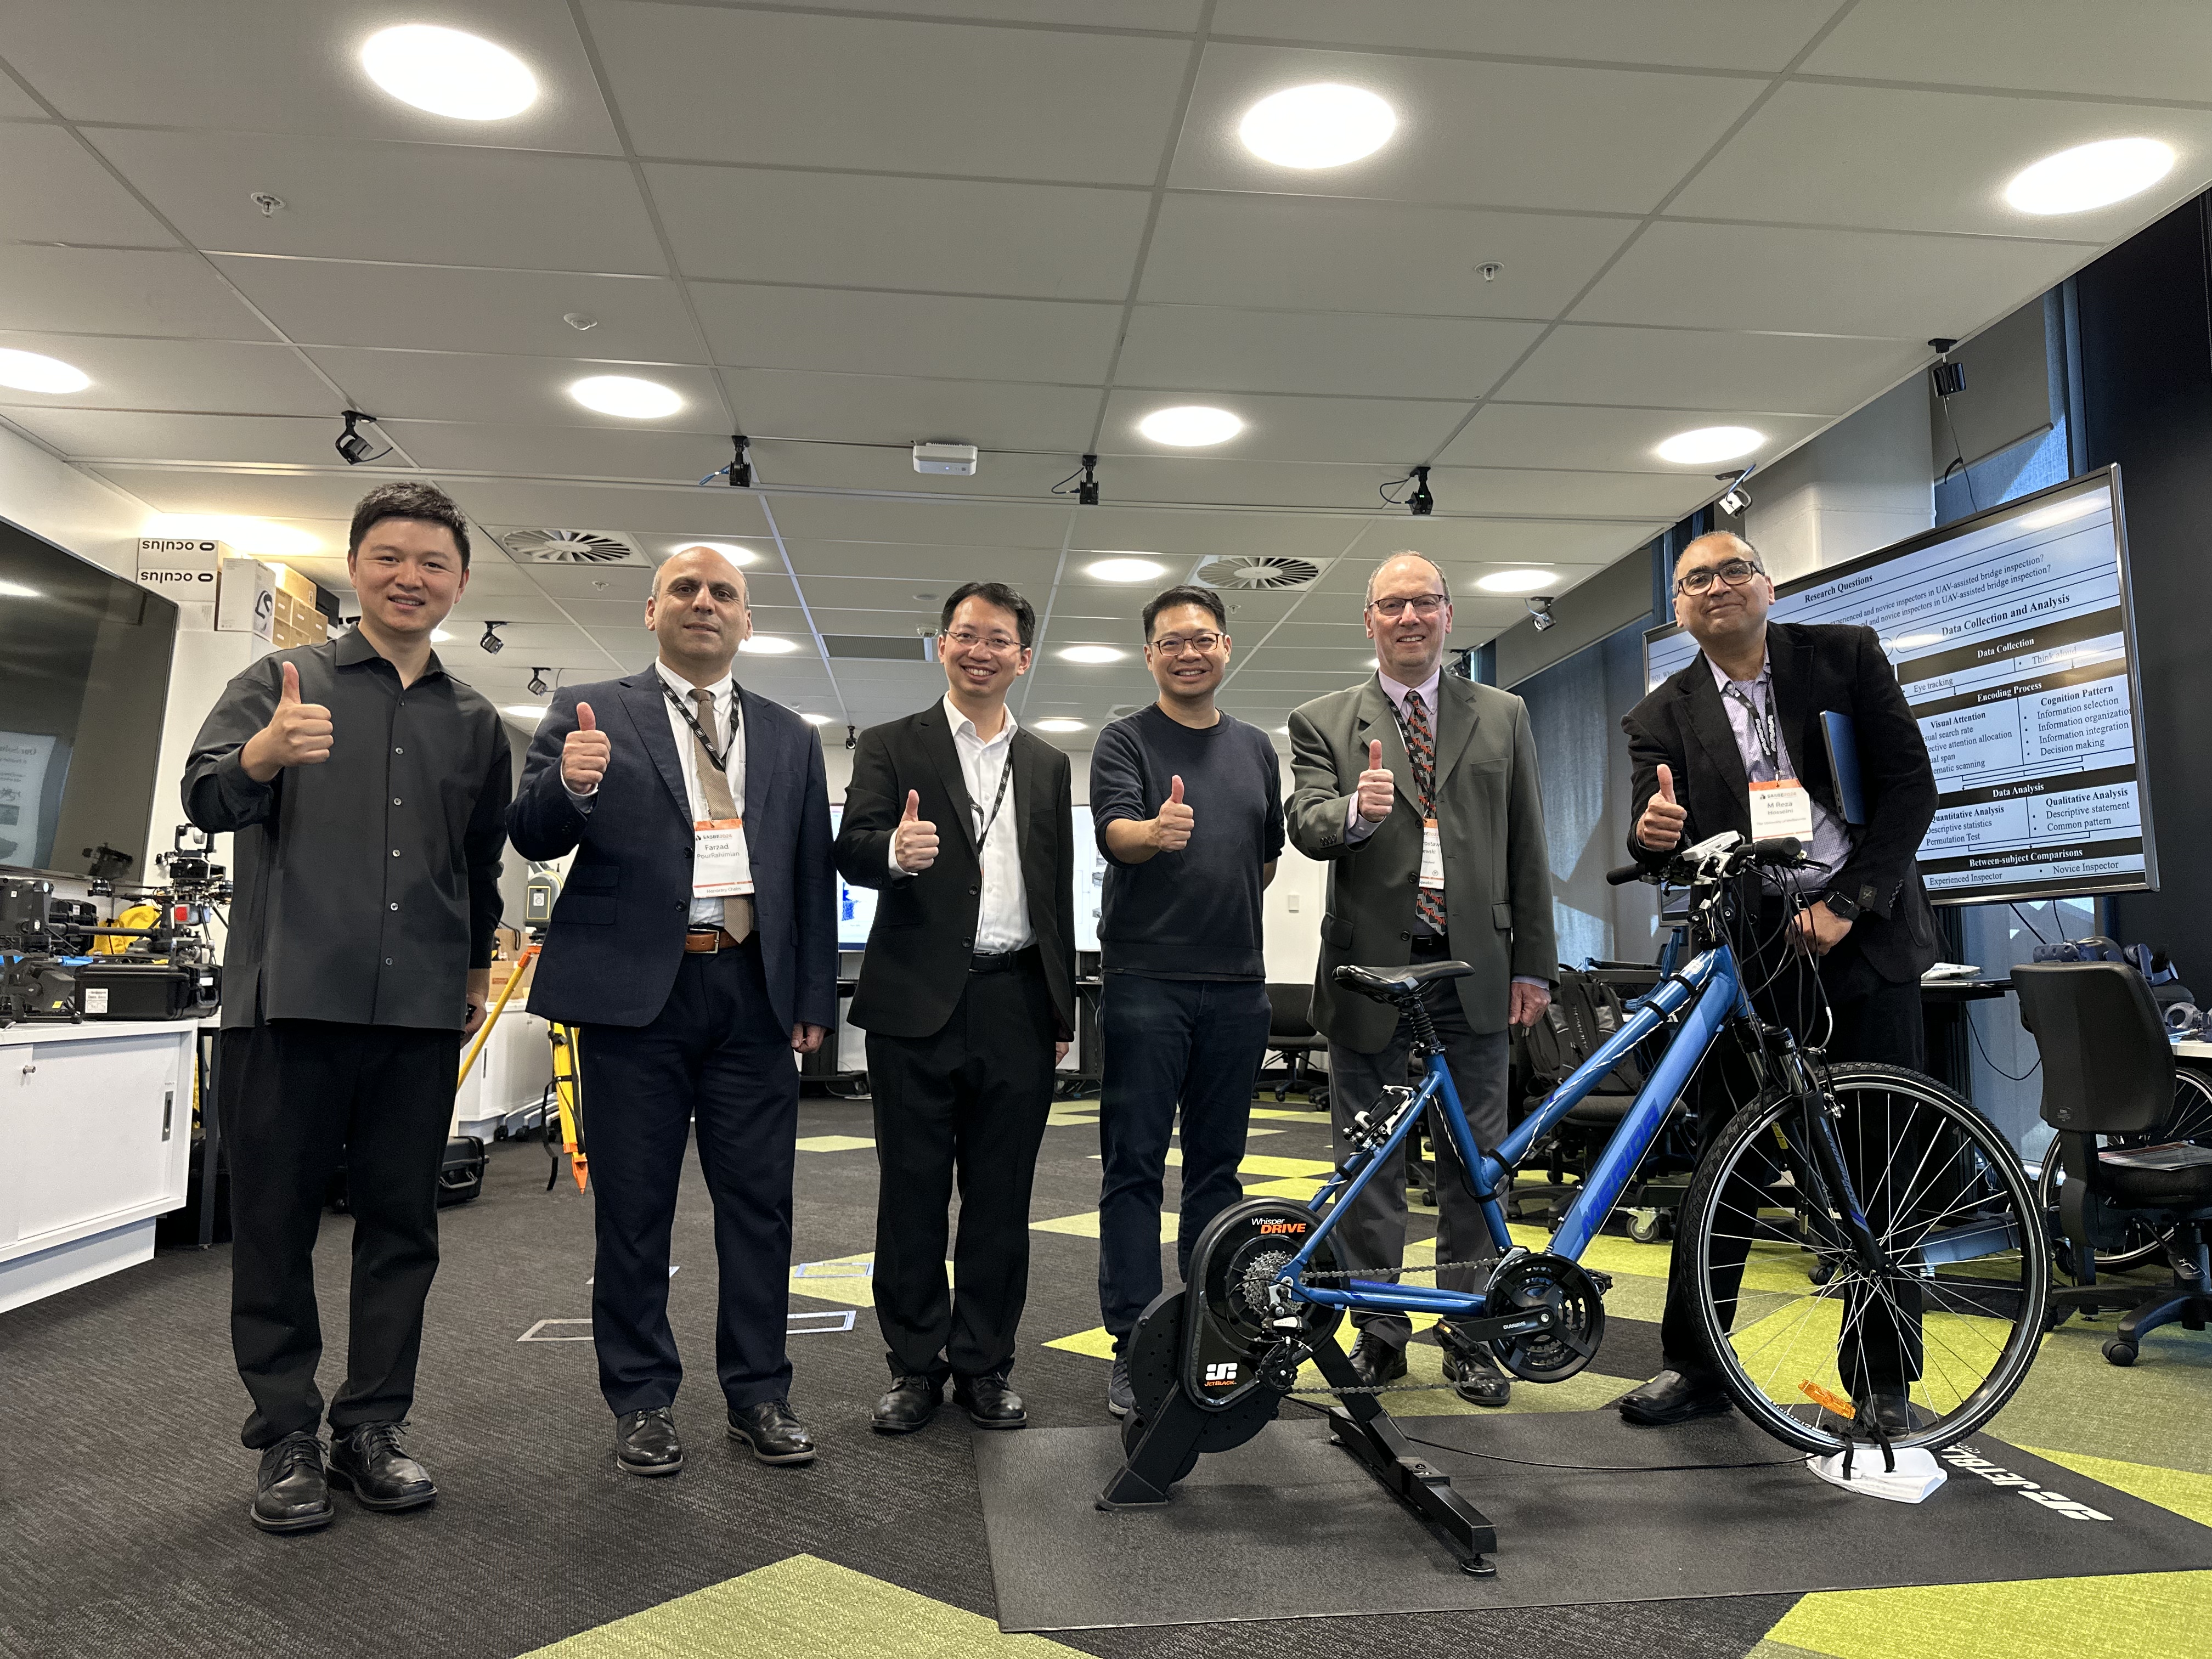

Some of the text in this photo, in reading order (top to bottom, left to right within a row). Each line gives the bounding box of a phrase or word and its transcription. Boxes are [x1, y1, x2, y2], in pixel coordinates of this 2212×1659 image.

[142, 540, 194, 552] oculus
[140, 571, 193, 584] oculus
[1864, 607, 1874, 617] and
[1875, 600, 1895, 613] novice
[1896, 592, 1927, 607] inspectors
[1928, 588, 1934, 596] in
[1936, 574, 1979, 594] UAV-assisted
[1980, 568, 2002, 580] bridge
[2004, 554, 2044, 573] inspection?
[1804, 575, 1873, 603] Research Questions
[1869, 617, 1880, 626] and
[1881, 610, 1900, 622] novice
[1901, 601, 1932, 616] inspectors
[1934, 597, 1940, 606] in
[1942, 584, 1985, 603] UAV-assisted
[1987, 578, 2009, 590] bridge
[2010, 564, 2051, 584] inspection?
[1942, 594, 2070, 636] Data Collection and Analysis
[1977, 637, 2034, 658] Data Collection
[2032, 646, 2077, 665] Think aloud
[1914, 676, 1954, 693] Eye tracking
[1977, 681, 2042, 703] Encoding Process
[2041, 685, 2113, 706] Cognition Pattern
[2037, 697, 2119, 720] Information selection
[1930, 712, 1986, 729] Visual Attention
[2038, 716, 2083, 732] Information
[1939, 729, 1959, 739] search
[1961, 726, 1973, 735] rate
[2039, 721, 2129, 744] Information integration
[1928, 731, 2012, 753] ective attention allocation
[2040, 738, 2105, 757] Decision making
[1940, 753, 1956, 763] span
[1956, 759, 1985, 771] scanning
[1993, 782, 2044, 798] Data Analysis
[2046, 787, 2128, 808] Qualitative Analysis
[1974, 805, 2004, 817] Analysis
[2046, 801, 2130, 819] Descriptive statement
[1963, 819, 1993, 830] statistics
[2047, 817, 2112, 831] Common pattern
[1926, 833, 1980, 846] Permutation Test
[1970, 849, 2083, 867] Between-subject Comparisons
[2053, 861, 2119, 874] Novice Inspector
[1929, 872, 2003, 887] Experienced Inspector
[1581, 1102, 1659, 1240] MERIDA
[1261, 1223, 1306, 1234] DRIVE
[1941, 1445, 2041, 1489] JETBLA
